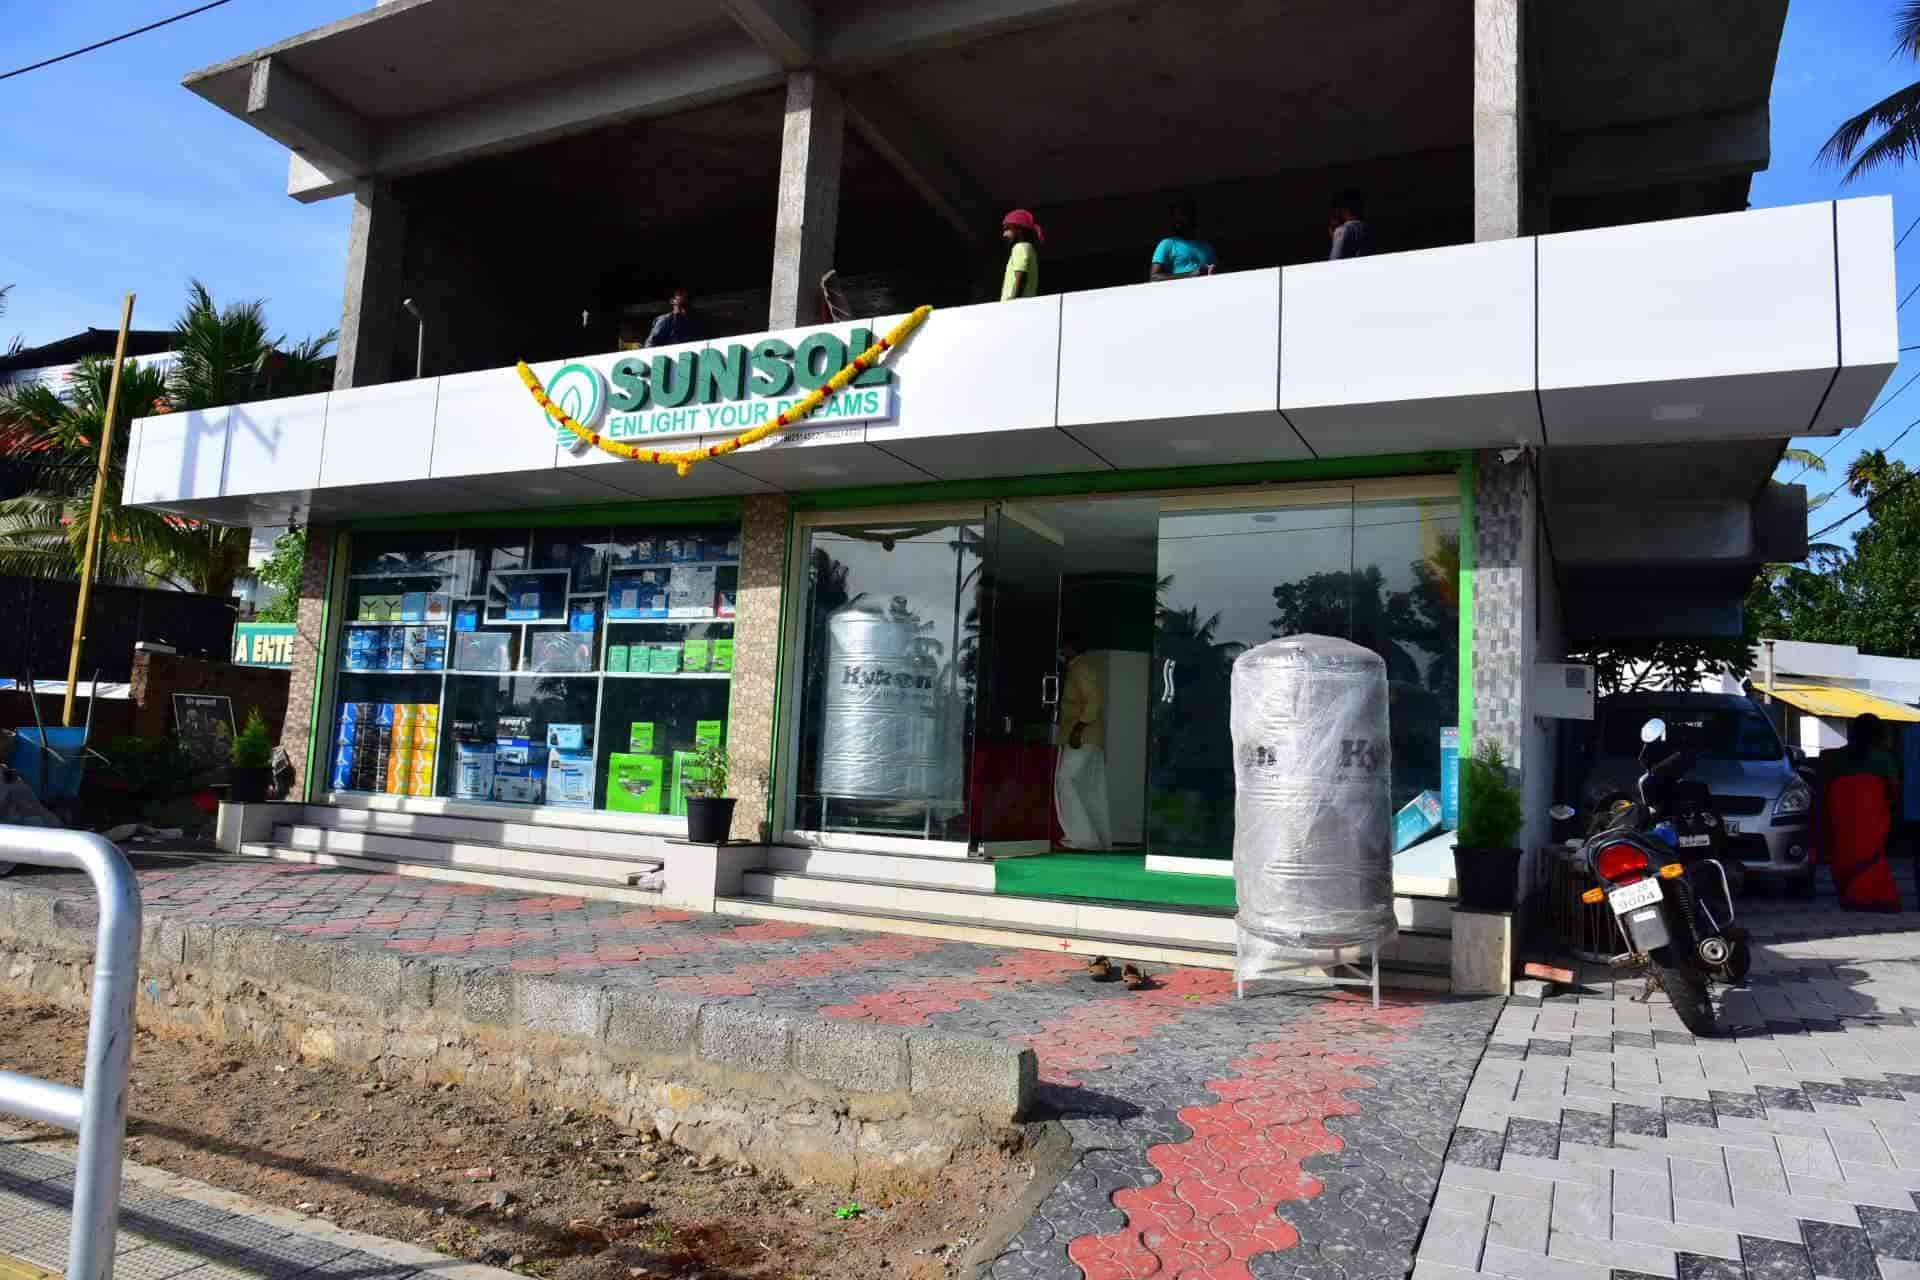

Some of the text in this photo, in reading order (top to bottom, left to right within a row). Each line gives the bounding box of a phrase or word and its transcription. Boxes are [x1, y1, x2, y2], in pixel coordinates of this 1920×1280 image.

[607, 327, 893, 412] SUNSOL
[609, 391, 880, 437] ENLIGHT YOUR DAMS
